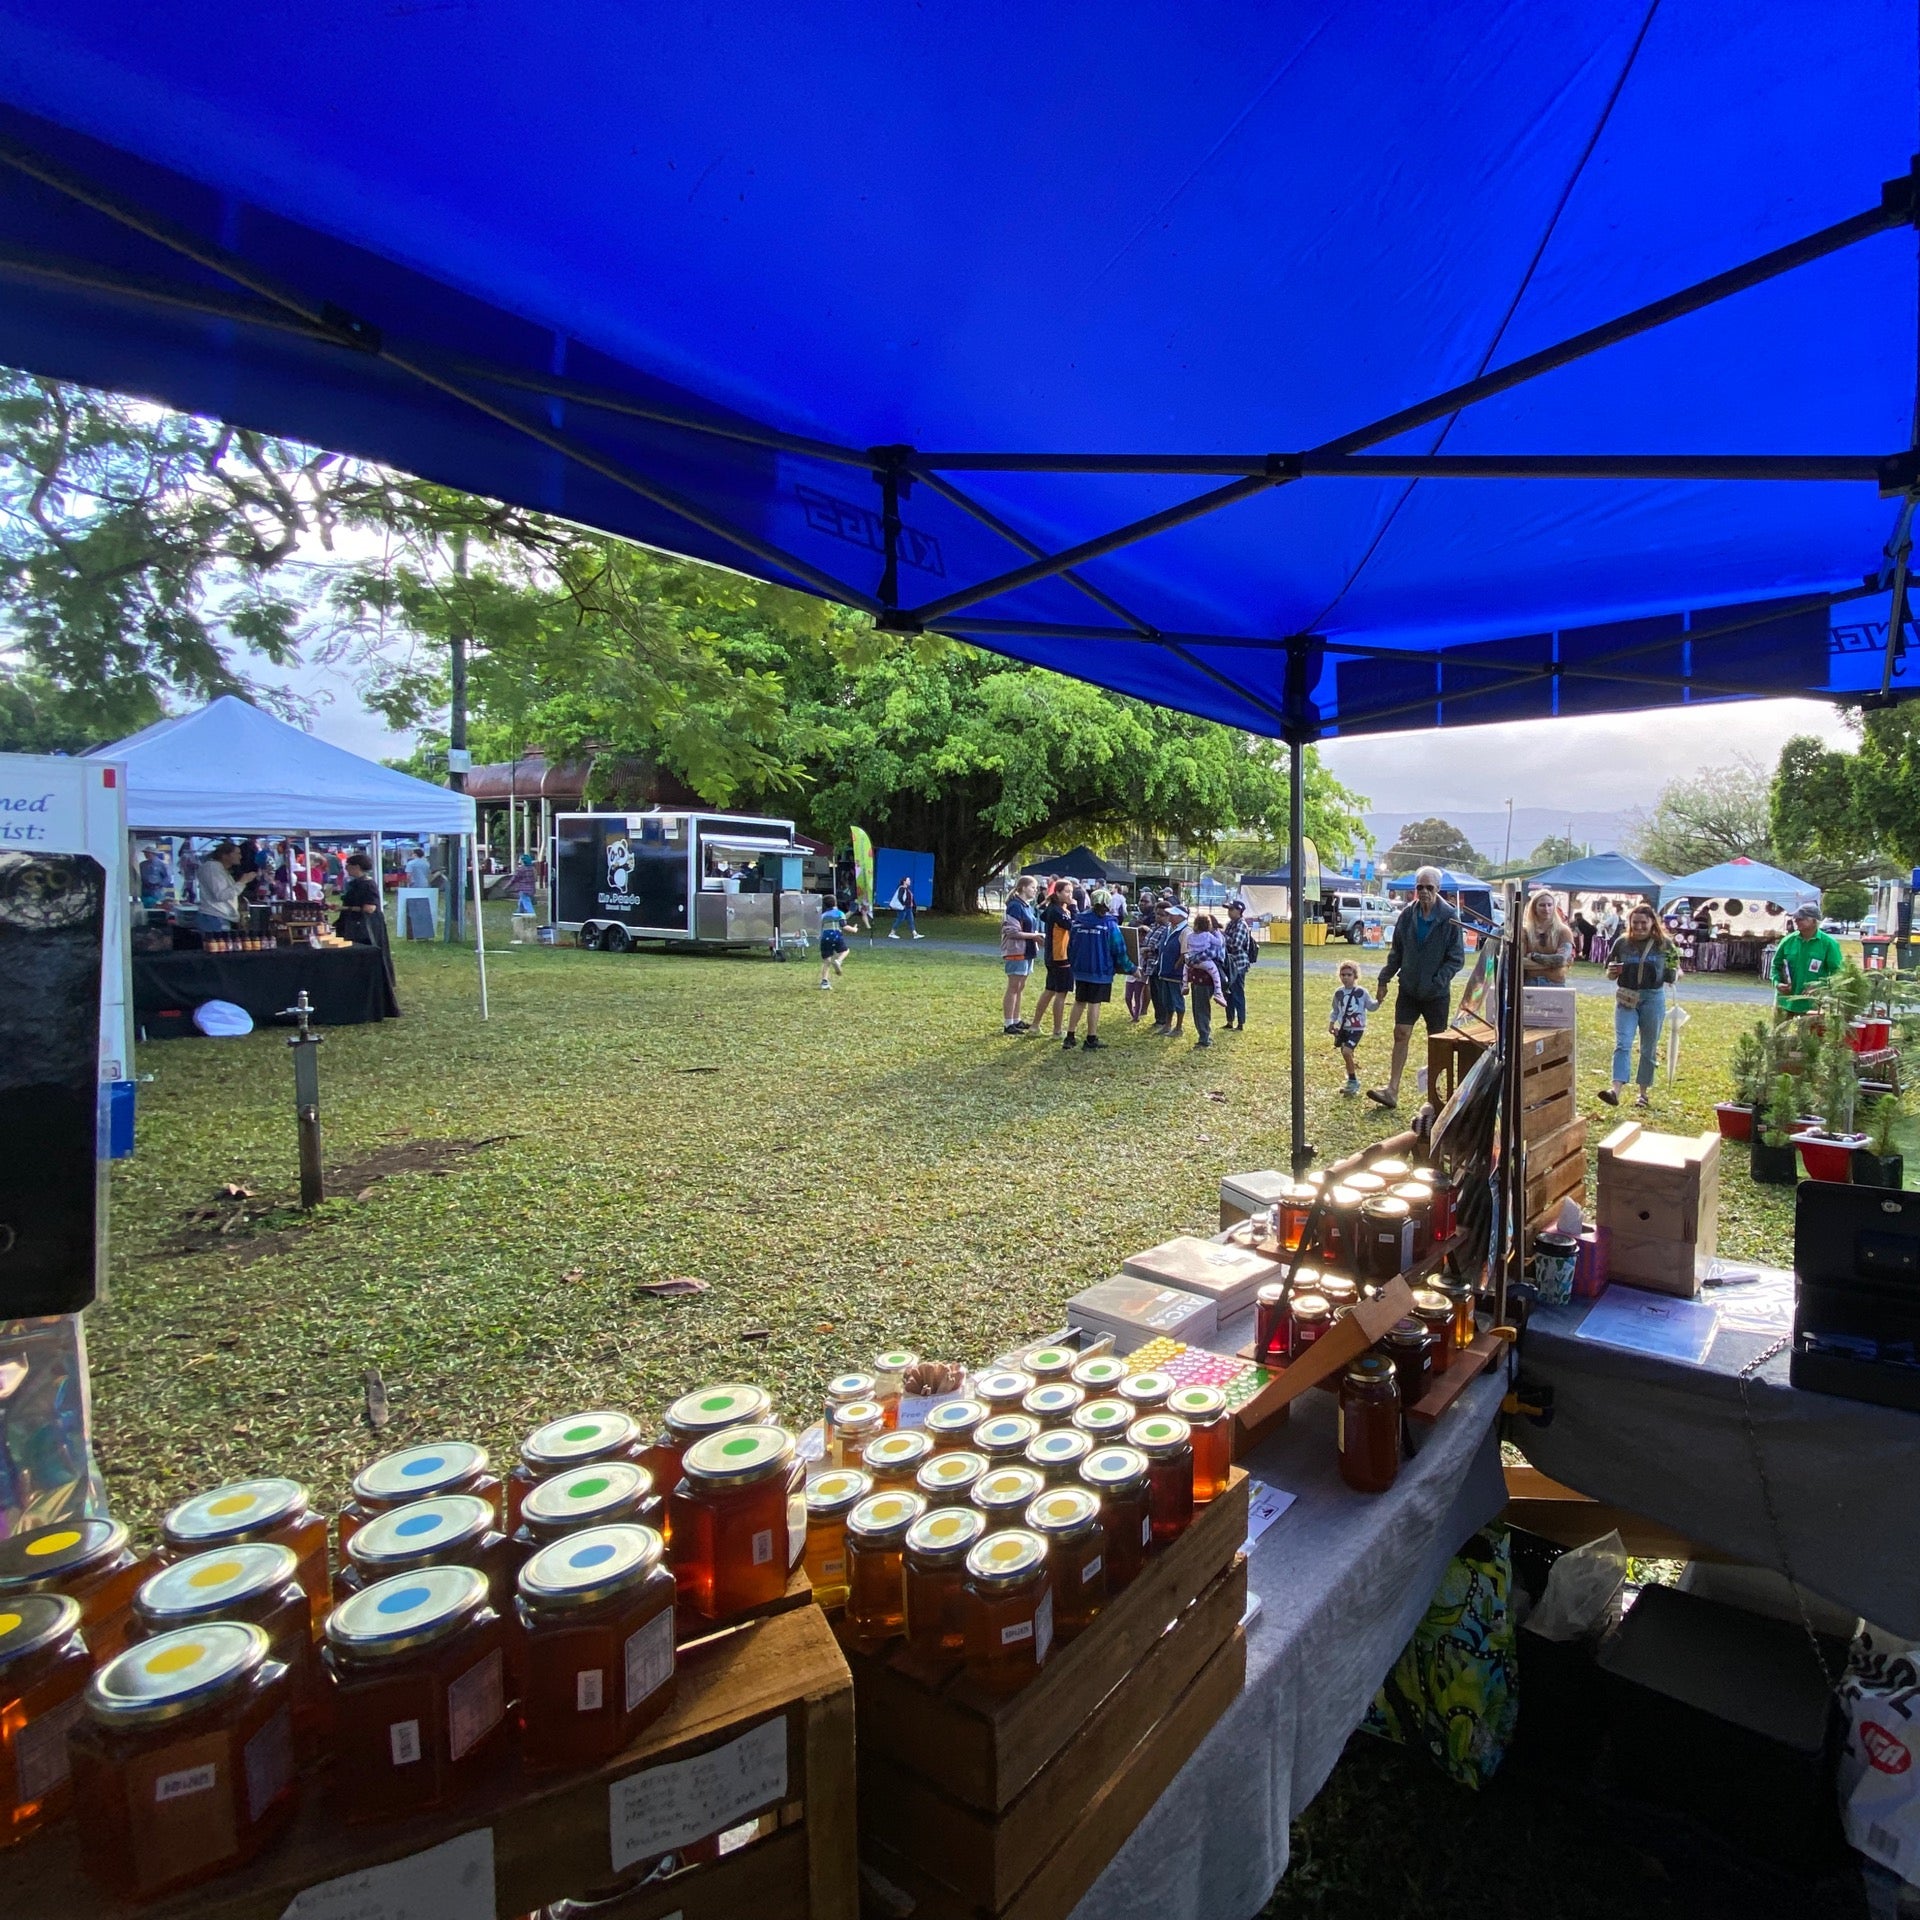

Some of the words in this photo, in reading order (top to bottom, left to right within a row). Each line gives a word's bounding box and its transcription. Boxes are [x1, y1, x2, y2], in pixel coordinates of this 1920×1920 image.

[0, 822, 45, 840] ist:
[1165, 1297, 1203, 1320] ABC
[1864, 1727, 1905, 1767] IGA
